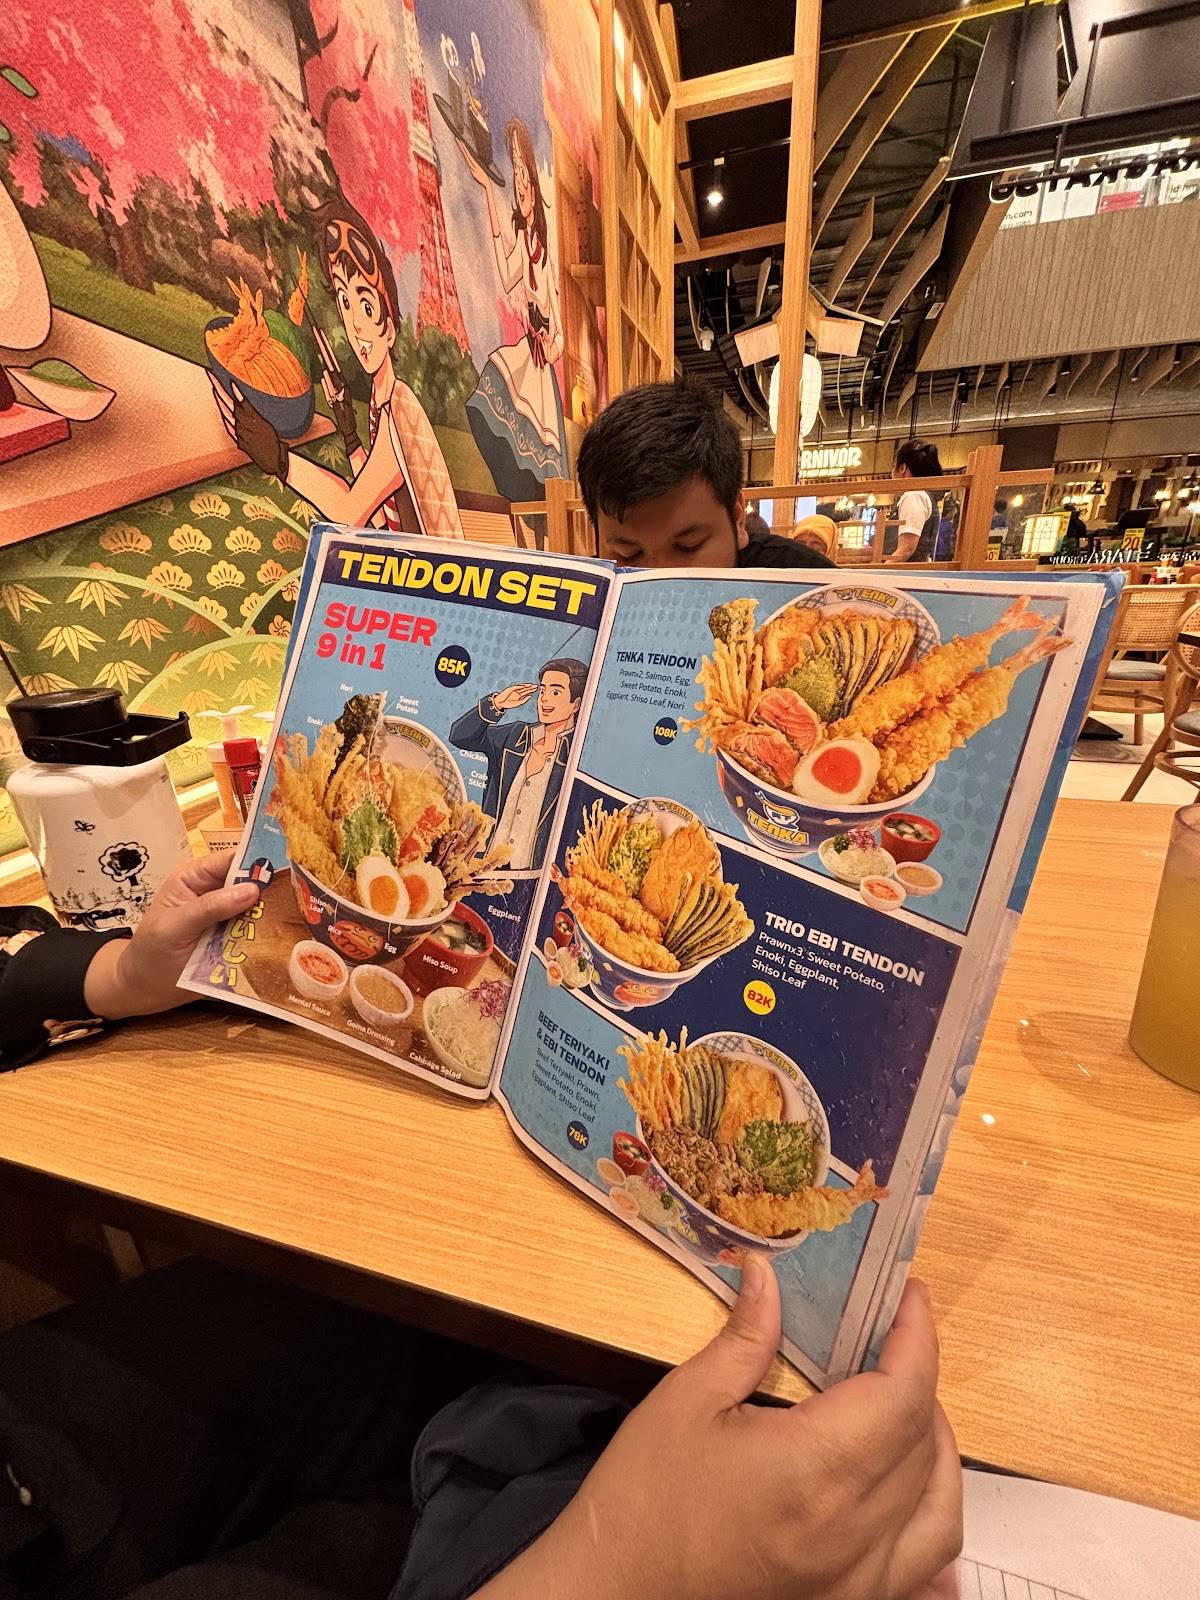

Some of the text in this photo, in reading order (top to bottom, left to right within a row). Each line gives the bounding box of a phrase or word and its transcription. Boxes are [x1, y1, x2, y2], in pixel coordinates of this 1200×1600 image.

[337, 549, 597, 616] TENDON SET
[323, 601, 438, 647] SUPER
[316, 632, 386, 671] 9 in 1
[616, 651, 697, 670] TENKA TENDON
[437, 656, 468, 677] 85K
[340, 683, 354, 693] Nori
[644, 671, 673, 684] Salmon,
[620, 680, 687, 699] Sweet Potato, Enoki,
[396, 703, 418, 714] Potato
[399, 695, 419, 706] Sweet
[630, 694, 648, 704] Shiso
[649, 696, 666, 708] Leaf,
[667, 700, 686, 711] Nori
[654, 725, 677, 739] 108K
[459, 749, 488, 763] Chicken
[468, 777, 487, 790] Stick
[470, 770, 488, 781] Crab
[309, 895, 327, 907] Shiso
[309, 904, 324, 914] Leaf
[487, 904, 522, 923] Eggplant
[327, 925, 342, 936] Rice
[383, 942, 398, 954] Egg
[765, 911, 926, 988] TRIO EBI TENDON
[422, 954, 458, 975] Miso Soup
[754, 945, 841, 991] Enoki, Eggplant,
[758, 931, 887, 994] Prawnx3, Sweet Potato,
[751, 958, 808, 990] Shiso Leaf
[288, 993, 331, 1017] Mental Sauce
[746, 988, 774, 1009] 82K
[346, 1019, 396, 1046] Goma Dressing
[537, 1010, 610, 1071] BEEF TERIYAKI
[409, 1051, 462, 1080] Cabbage Salad
[536, 1027, 606, 1087] & EBI TENDON
[537, 1047, 549, 1063] Beef
[576, 1078, 601, 1103] Prawn,
[534, 1059, 598, 1114] Sweet Potato, Enoki,
[558, 1093, 577, 1113] Shiso
[578, 1108, 596, 1124] Leaf
[568, 1126, 588, 1147] 78K
